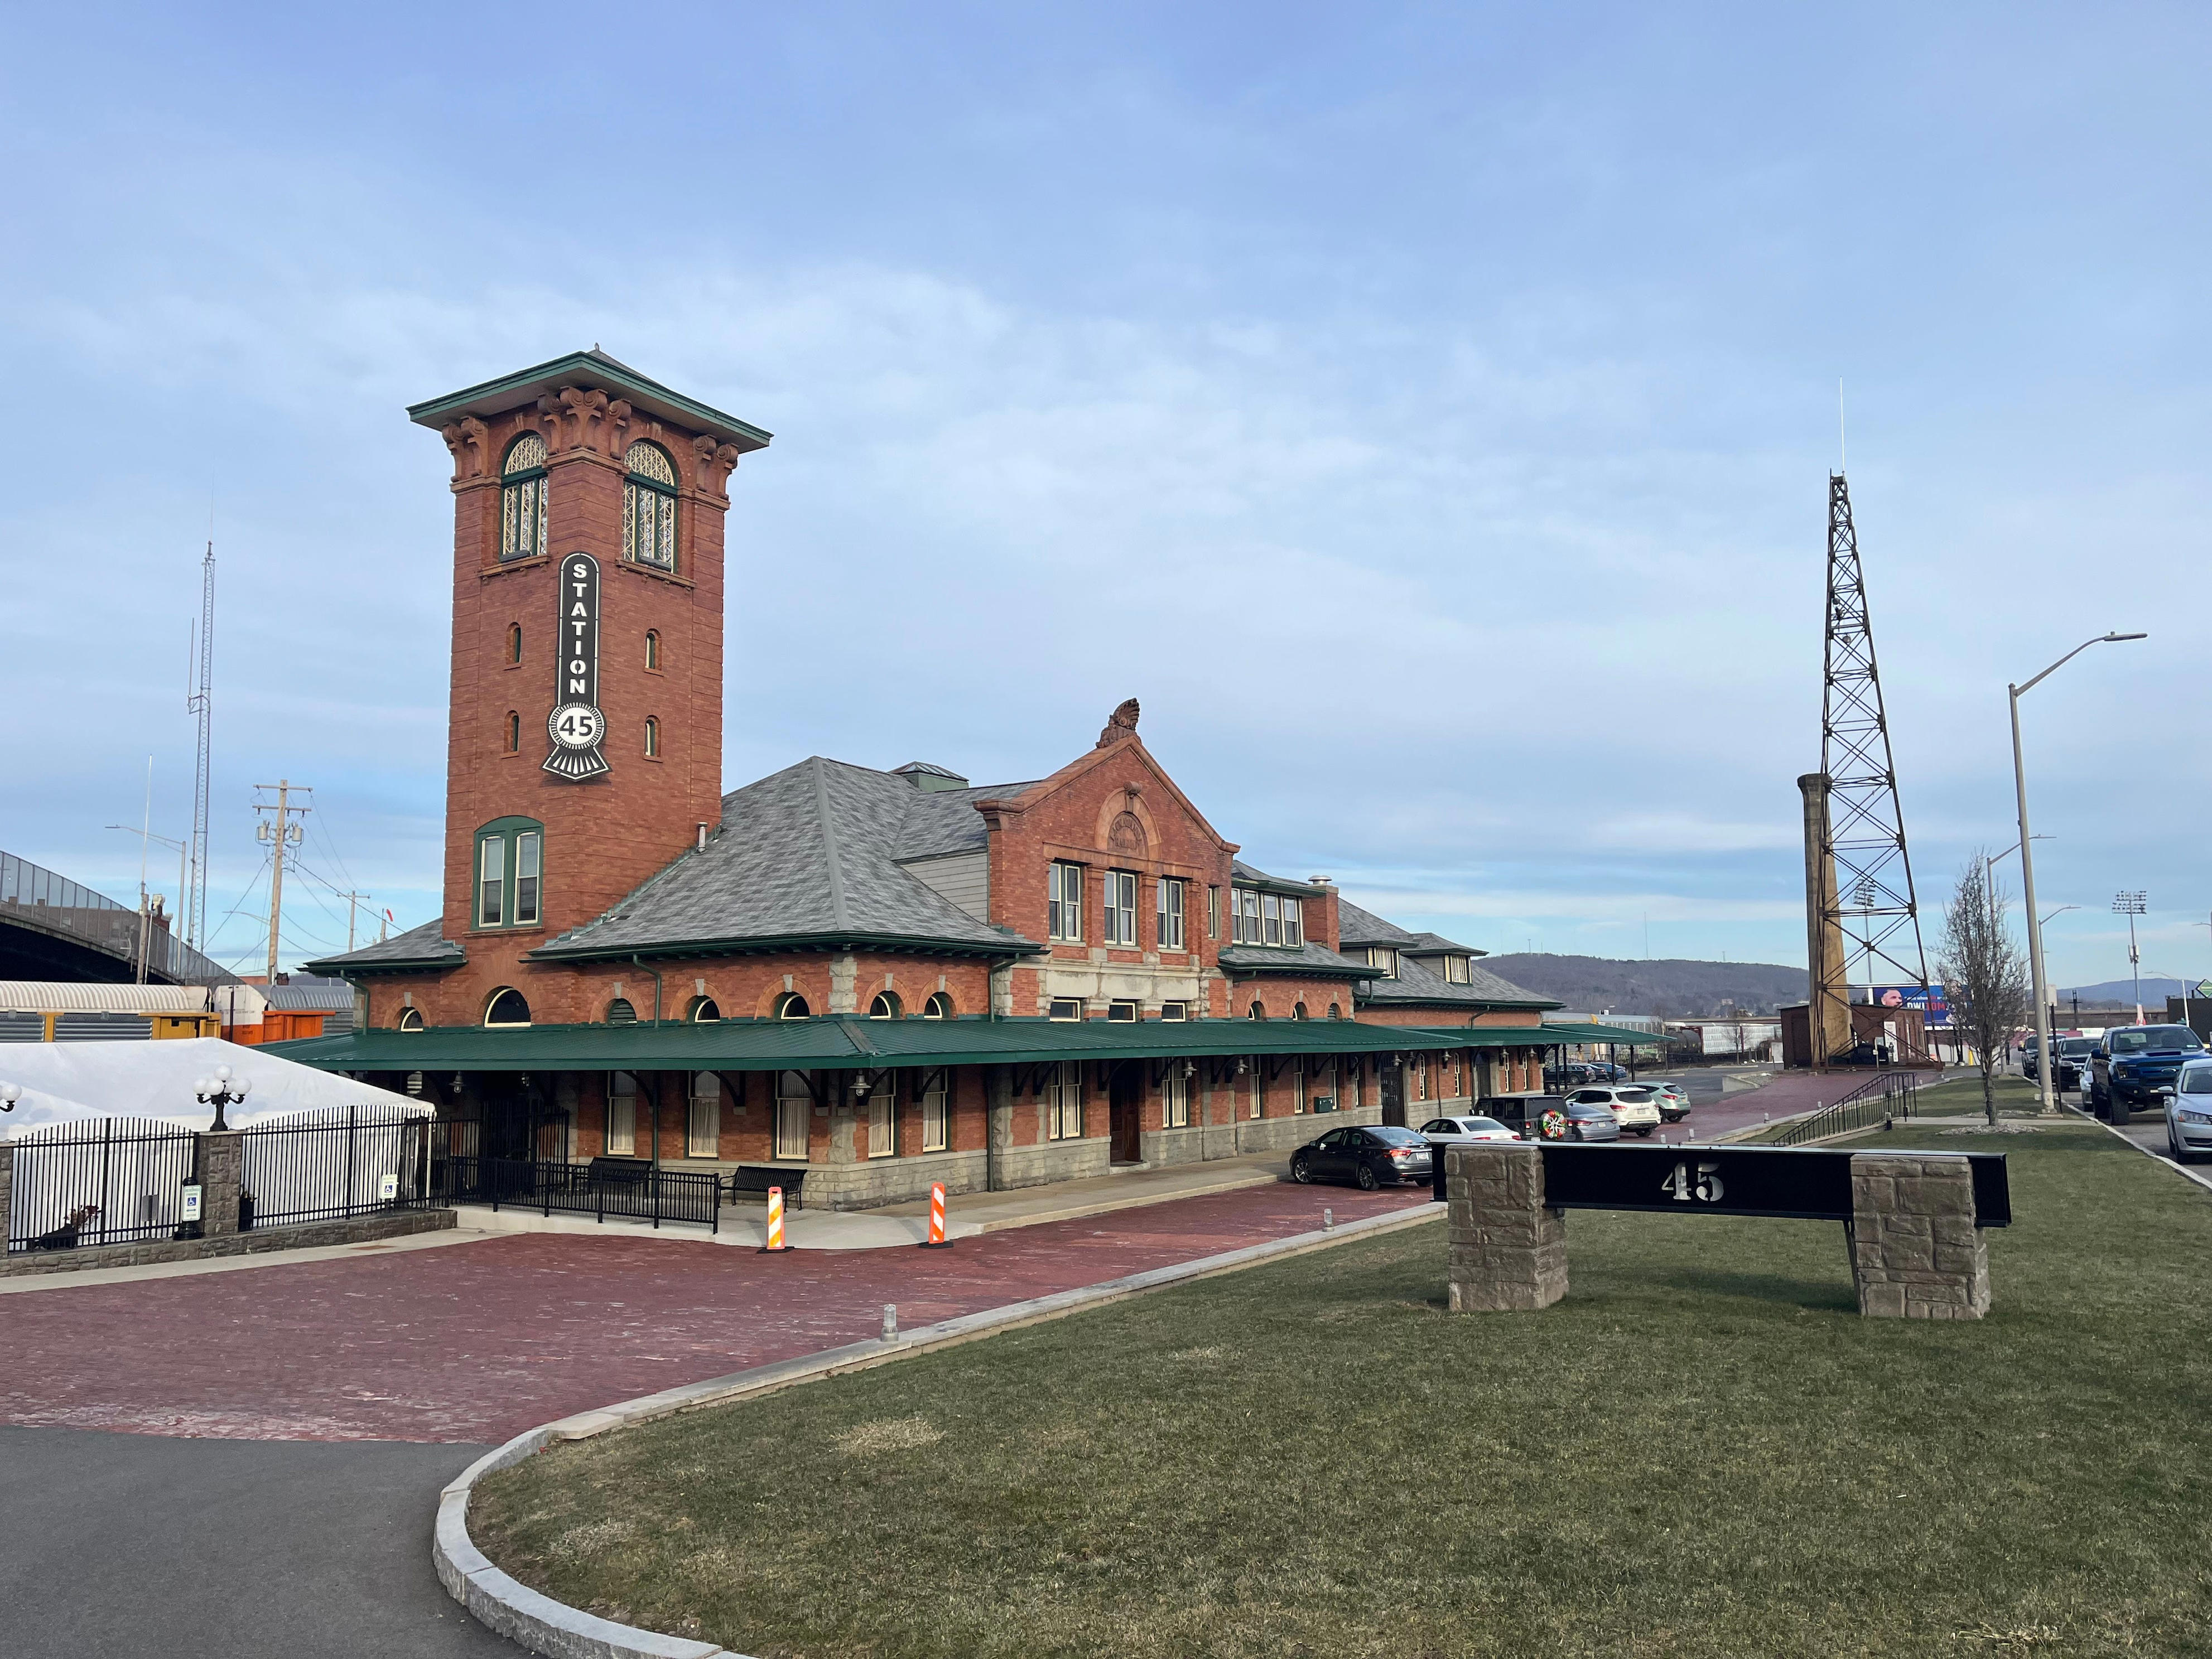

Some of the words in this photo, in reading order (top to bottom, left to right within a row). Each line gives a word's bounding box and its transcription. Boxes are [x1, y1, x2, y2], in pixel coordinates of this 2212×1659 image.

[569, 563, 587, 694] STATION
[559, 715, 592, 737] 45
[1661, 1161, 1724, 1202] 45
